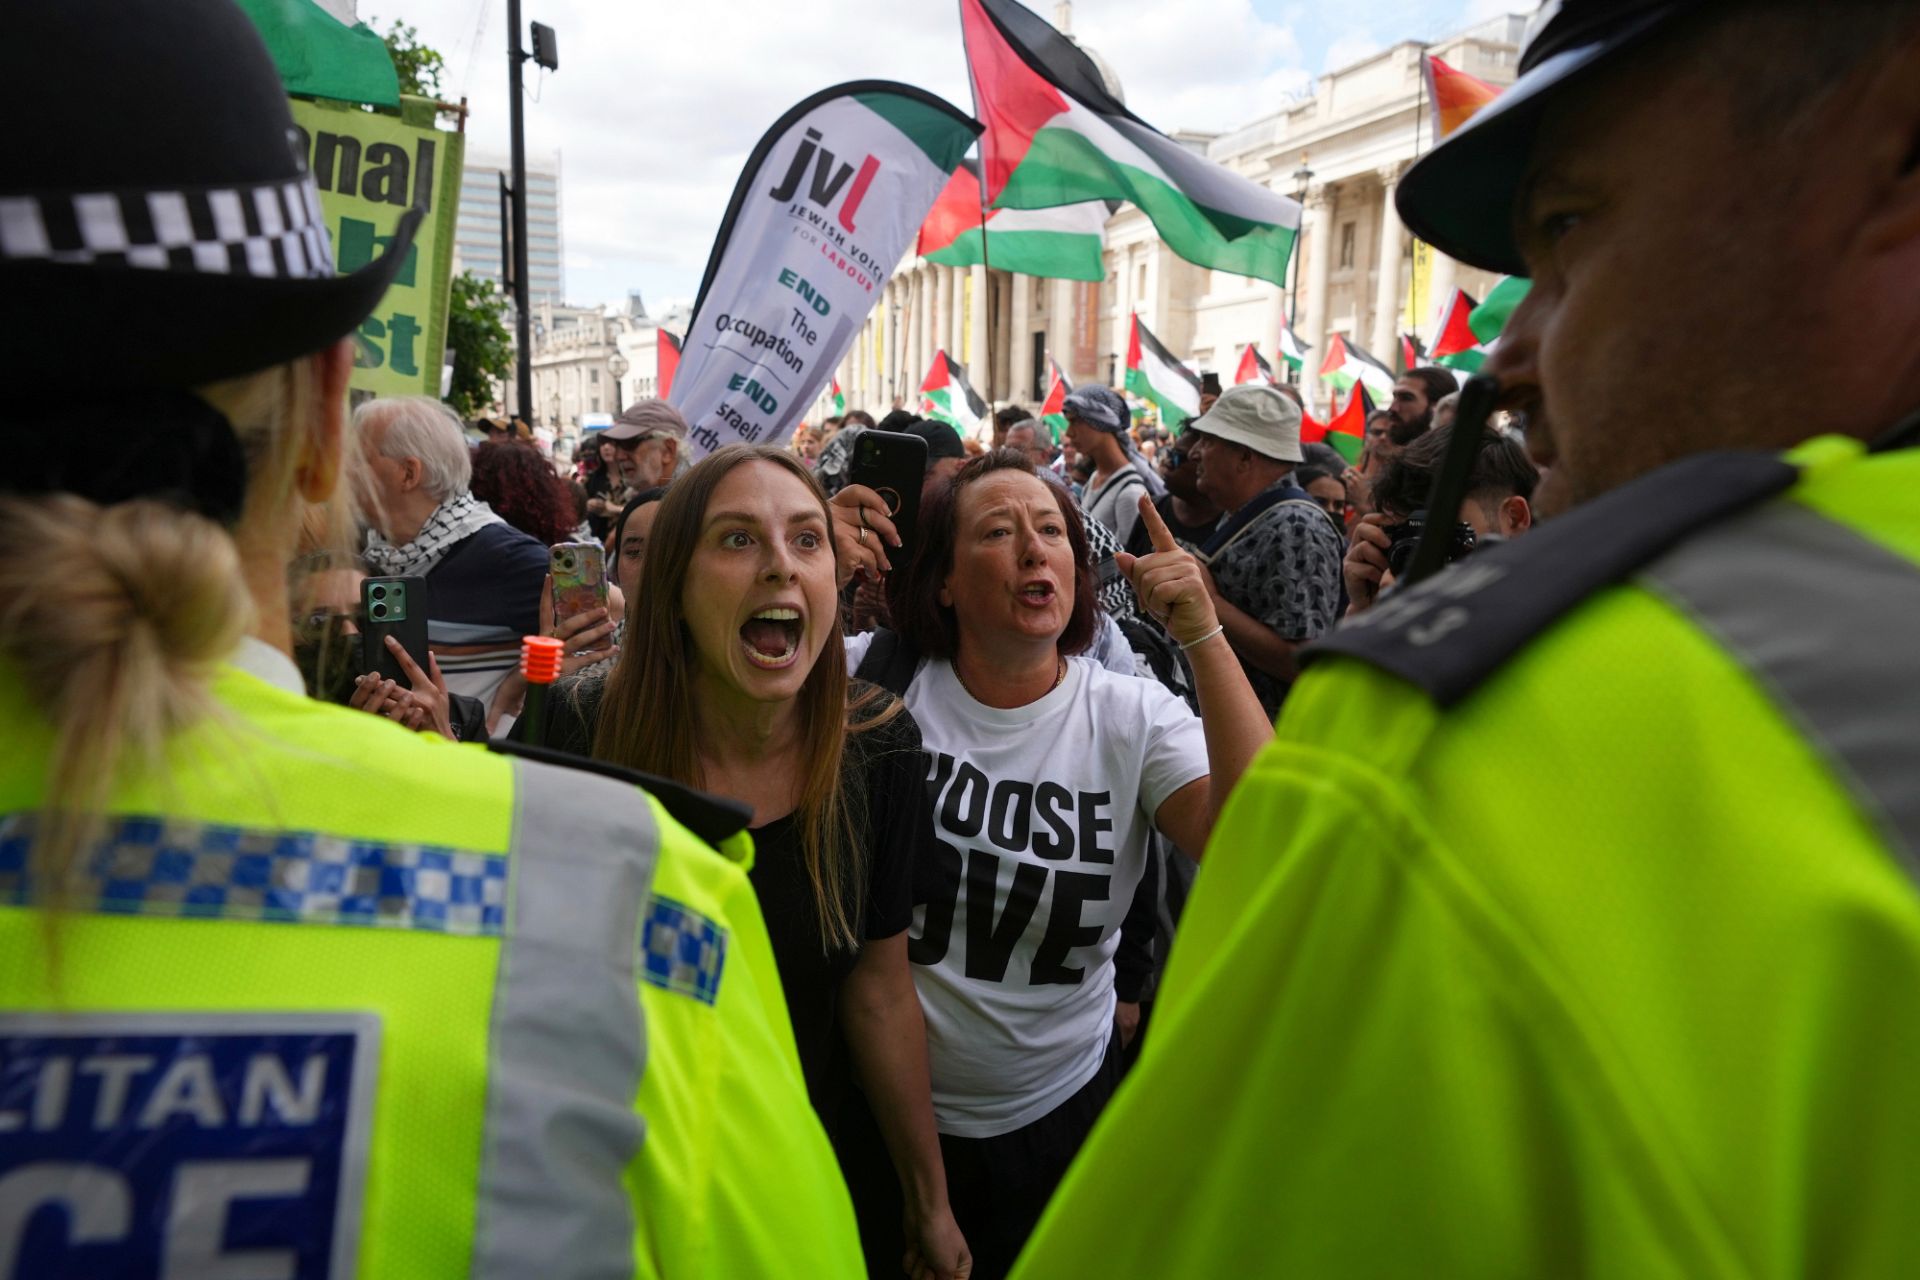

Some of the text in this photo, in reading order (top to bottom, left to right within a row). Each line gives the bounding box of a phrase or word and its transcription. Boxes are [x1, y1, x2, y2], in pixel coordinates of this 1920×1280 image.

[296, 122, 436, 214] nal
[769, 127, 880, 234] jvl
[789, 203, 845, 247] JEWISH
[793, 225, 873, 294] FOR LABOUR
[777, 267, 831, 317] END
[715, 313, 804, 375] Occupation
[790, 307, 818, 346] The
[727, 372, 778, 416] END
[715, 401, 763, 443] sraeli
